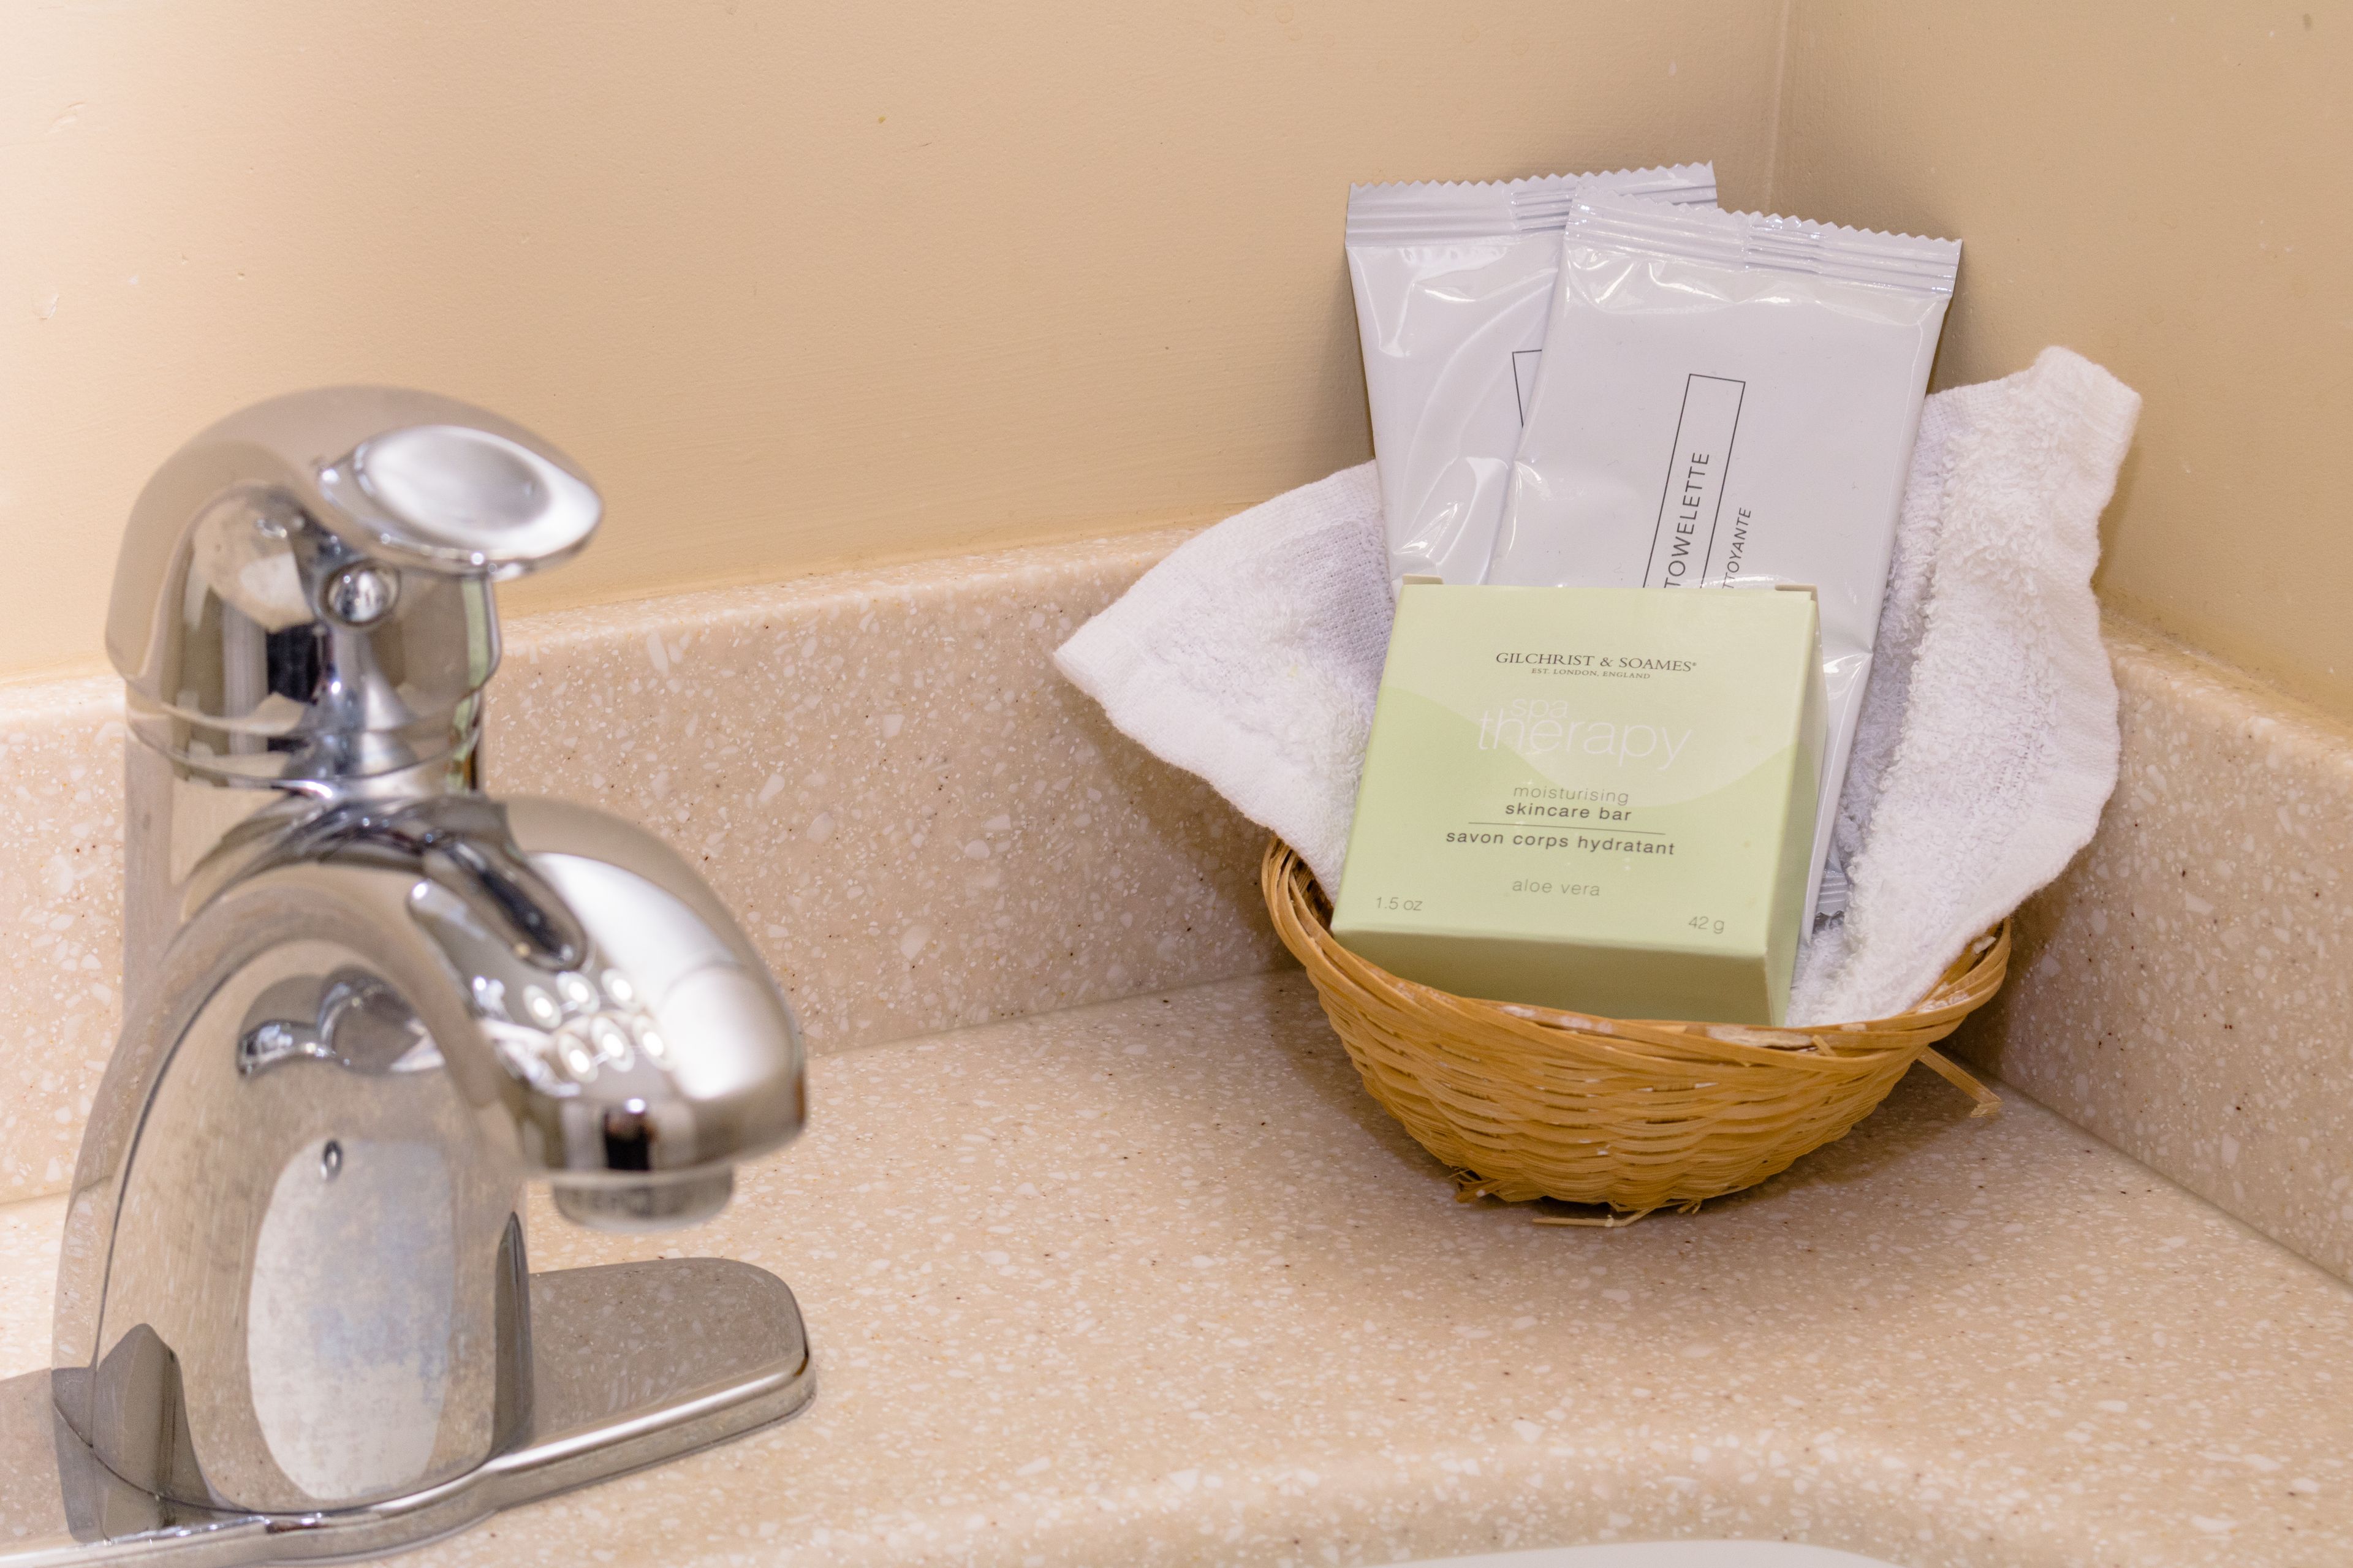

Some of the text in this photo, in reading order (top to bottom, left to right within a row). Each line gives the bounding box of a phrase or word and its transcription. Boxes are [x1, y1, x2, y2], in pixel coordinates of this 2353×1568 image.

[1664, 452, 1710, 588] TOWELETTE
[1496, 653, 1594, 666] GILCHRIST
[1600, 657, 1613, 667] &
[1553, 668, 1599, 677] LONDON,
[1510, 699, 1568, 723] spa
[1479, 708, 1692, 770] therapy
[1514, 787, 1629, 806] moisturising
[1506, 803, 1632, 821] skincare bar
[1446, 832, 1675, 855] savon corps hydratant
[1512, 879, 1601, 896] aloe vera
[1376, 897, 1423, 911] 1.5 oz
[1689, 917, 1725, 934] 42 g
